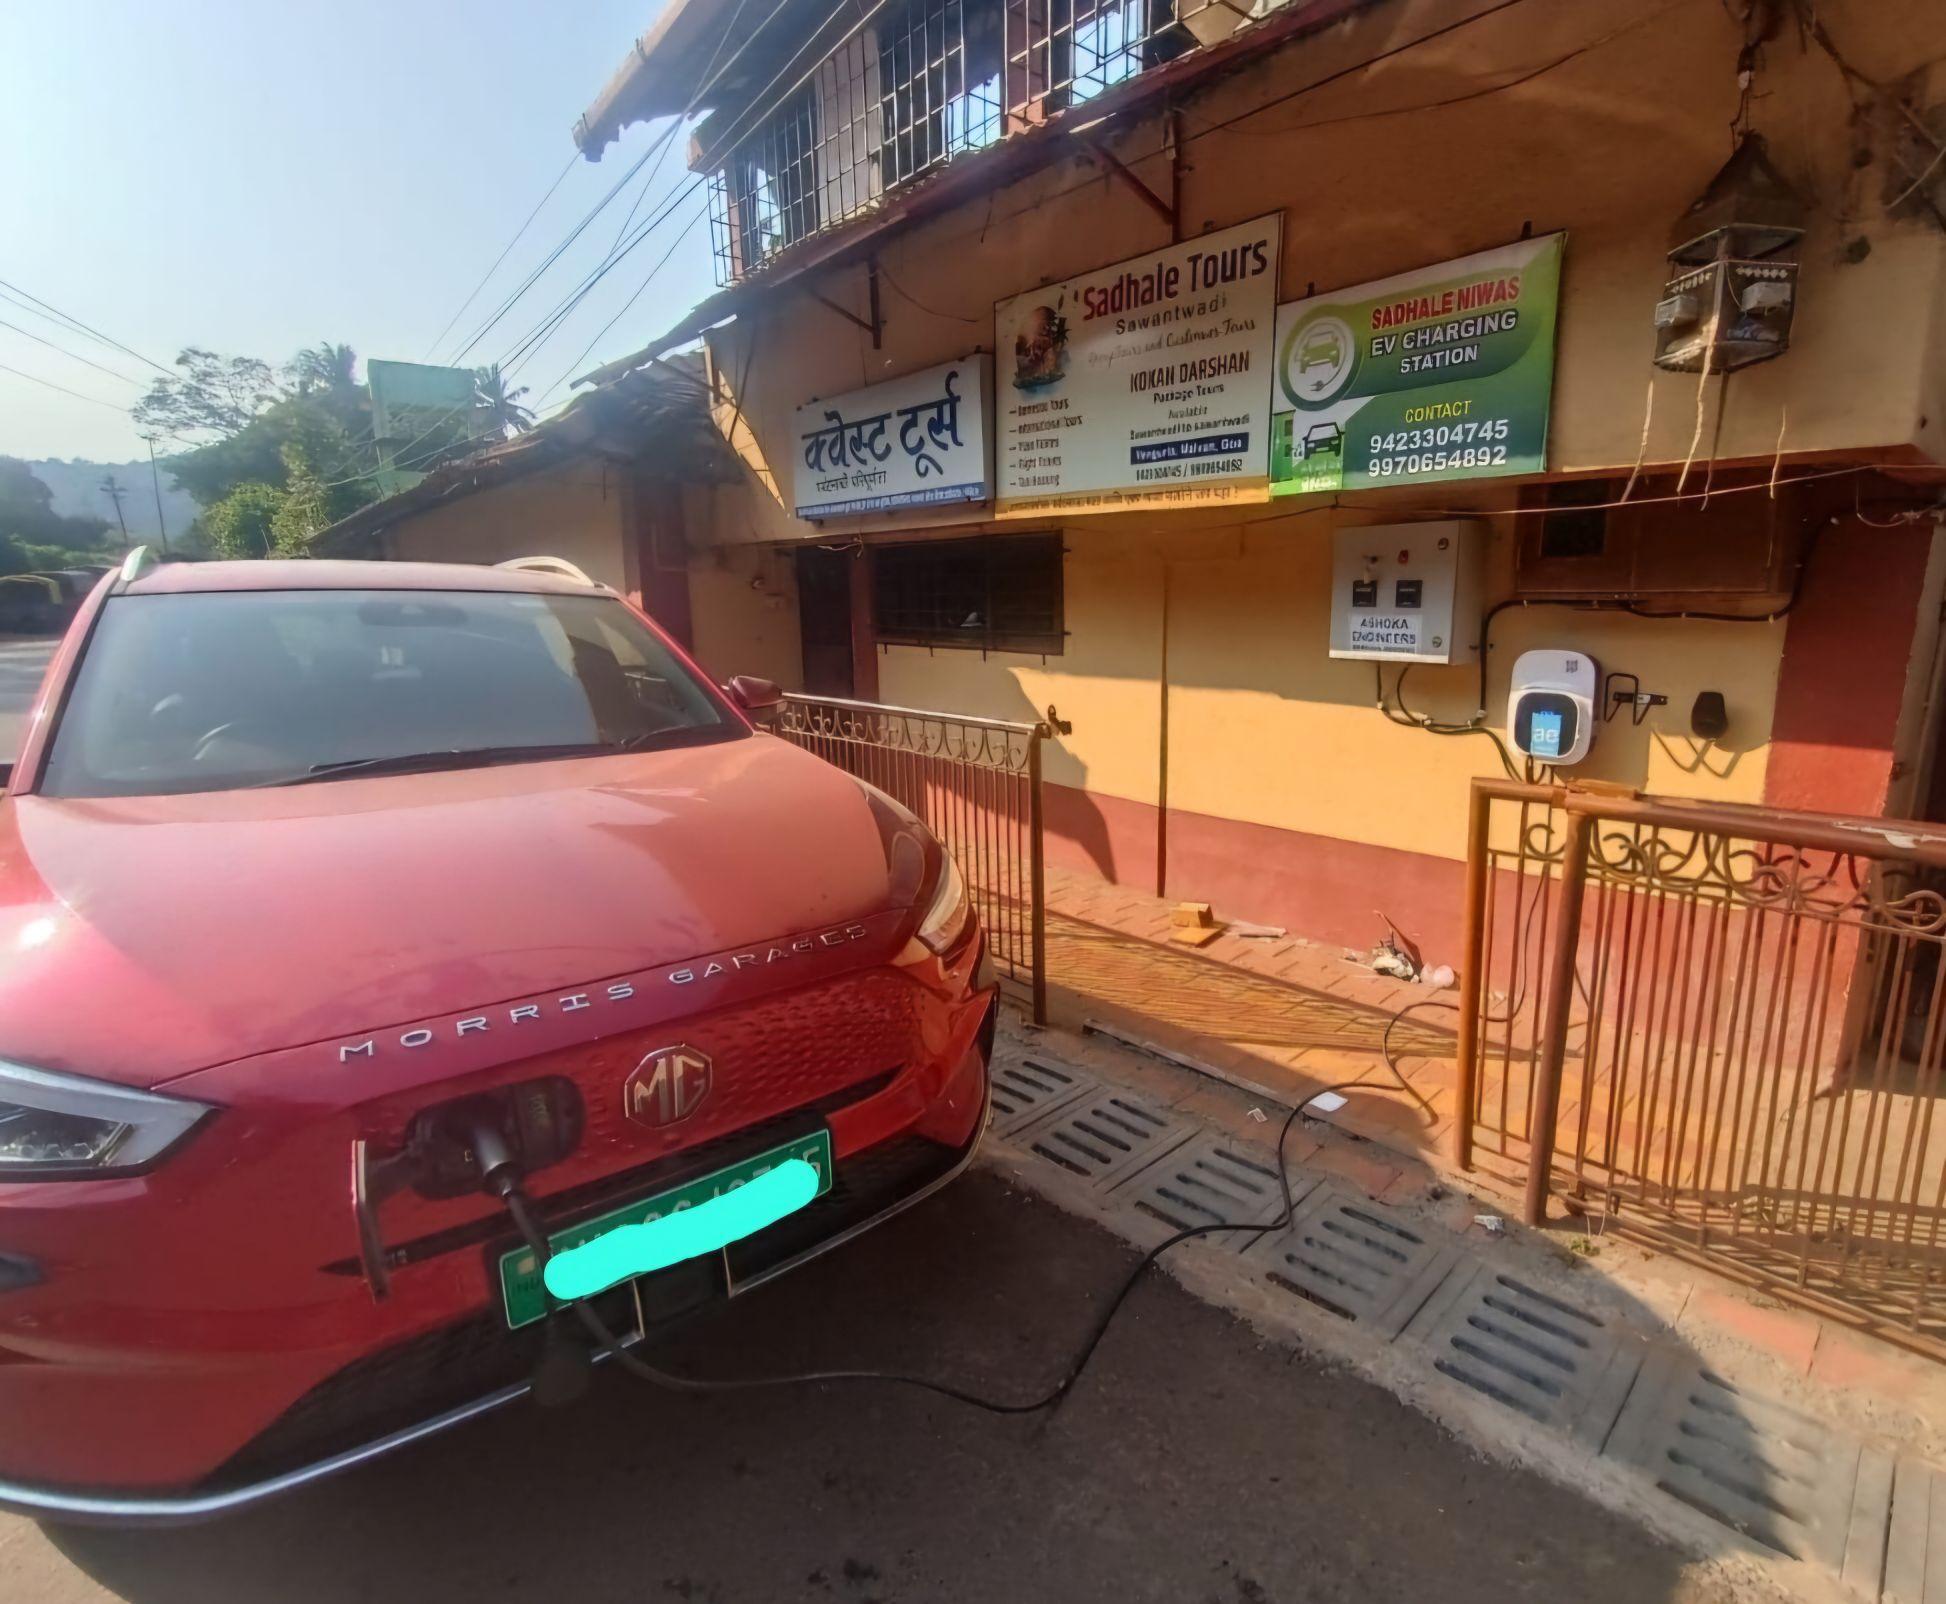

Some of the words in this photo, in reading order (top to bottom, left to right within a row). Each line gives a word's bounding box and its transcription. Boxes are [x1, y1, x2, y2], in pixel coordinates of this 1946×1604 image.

[1083, 262, 1179, 321] Sadhale
[1187, 240, 1267, 292] Tours
[1372, 291, 1454, 330] SADHALE
[1457, 276, 1520, 312] NIWAS
[1116, 292, 1227, 335] Sawantwadi
[1371, 334, 1398, 357] EV
[1402, 309, 1518, 350] CHARGING
[1130, 365, 1174, 392] KOKAN
[1180, 350, 1249, 383] DARSHAN
[1400, 344, 1478, 374] STATION
[801, 410, 892, 472] क्वेस्ट
[897, 370, 964, 478] टूर्स
[1405, 400, 1472, 423] CONTACT
[1370, 419, 1509, 454] 9423304745
[1368, 446, 1507, 477] 9970654892
[339, 982, 634, 1062] MORRIS
[668, 925, 867, 984] GARAGES
[634, 1055, 705, 1121] MG
